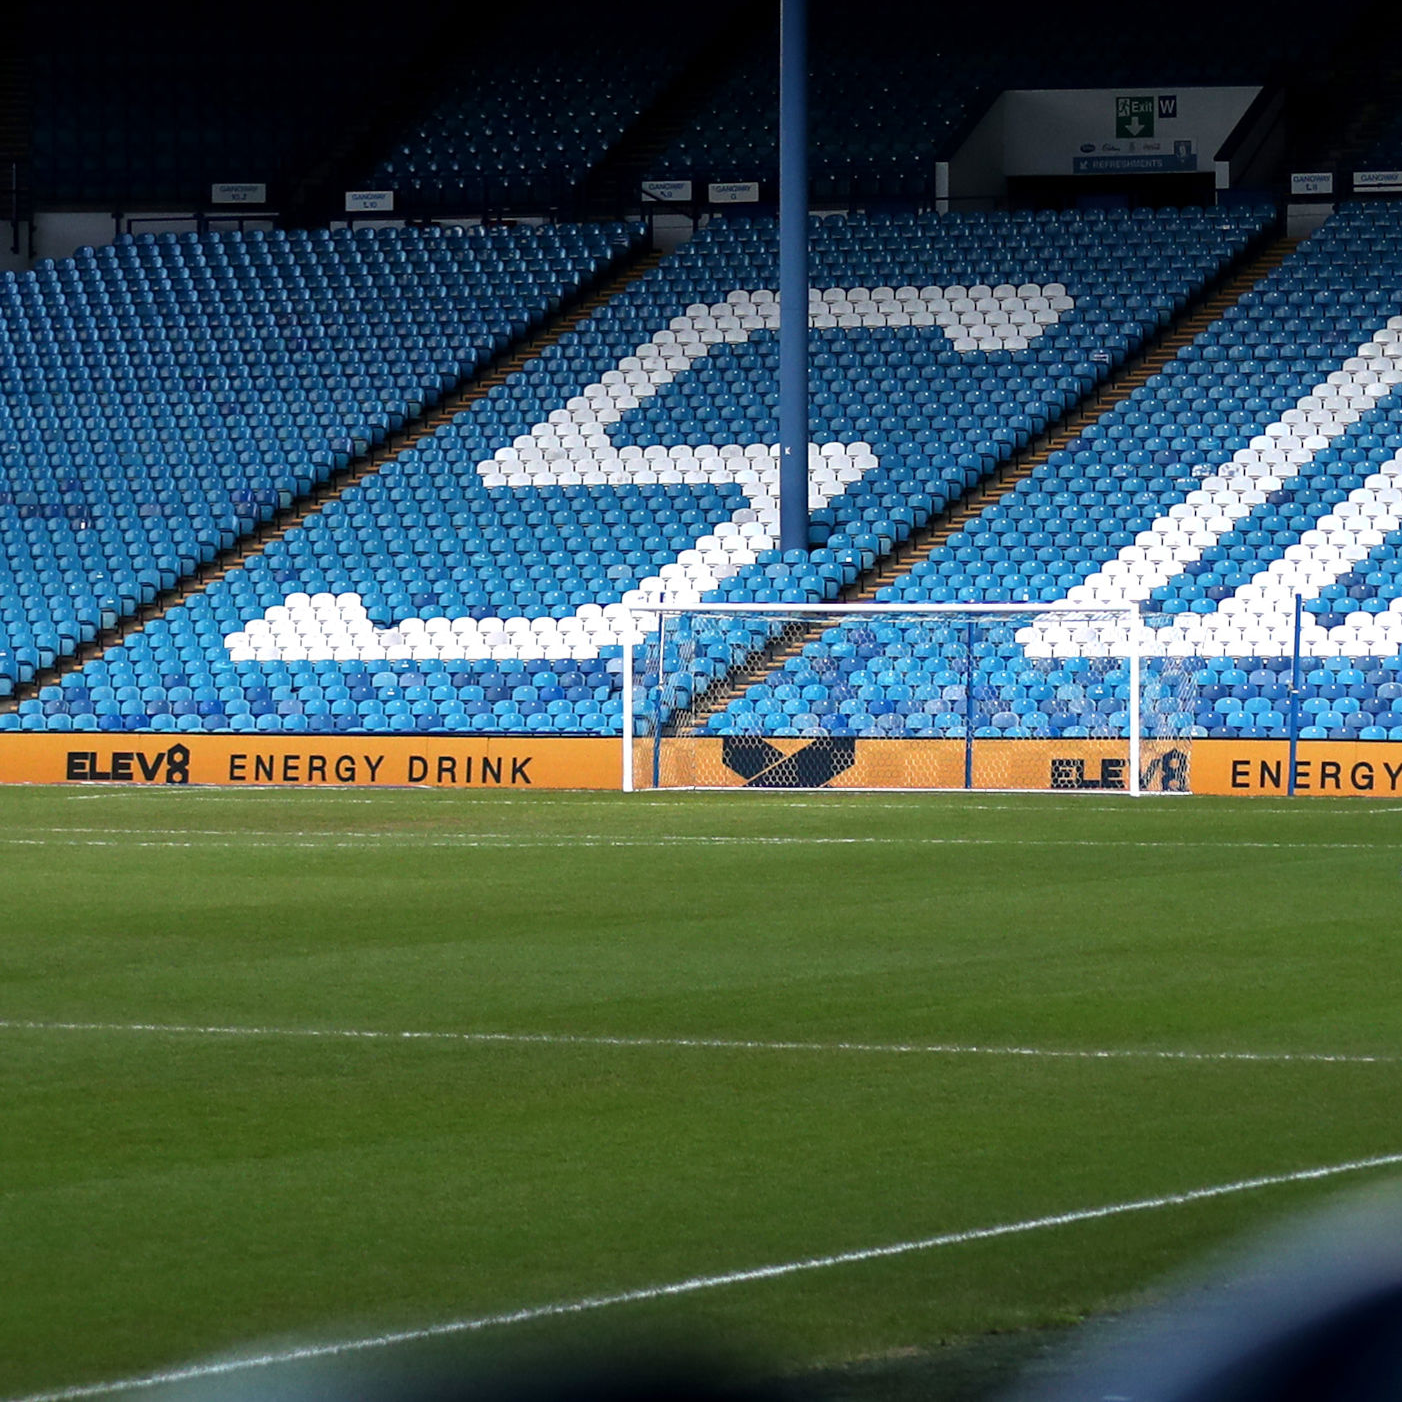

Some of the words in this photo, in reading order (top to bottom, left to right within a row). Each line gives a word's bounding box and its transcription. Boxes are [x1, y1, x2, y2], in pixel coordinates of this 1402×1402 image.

[1131, 101, 1153, 113] Exit
[1159, 99, 1175, 114] W
[1092, 158, 1164, 169] REFRESHMENTS
[66, 743, 190, 784] ELEV8
[230, 754, 385, 784] ENERGY
[408, 755, 532, 784] DRINK
